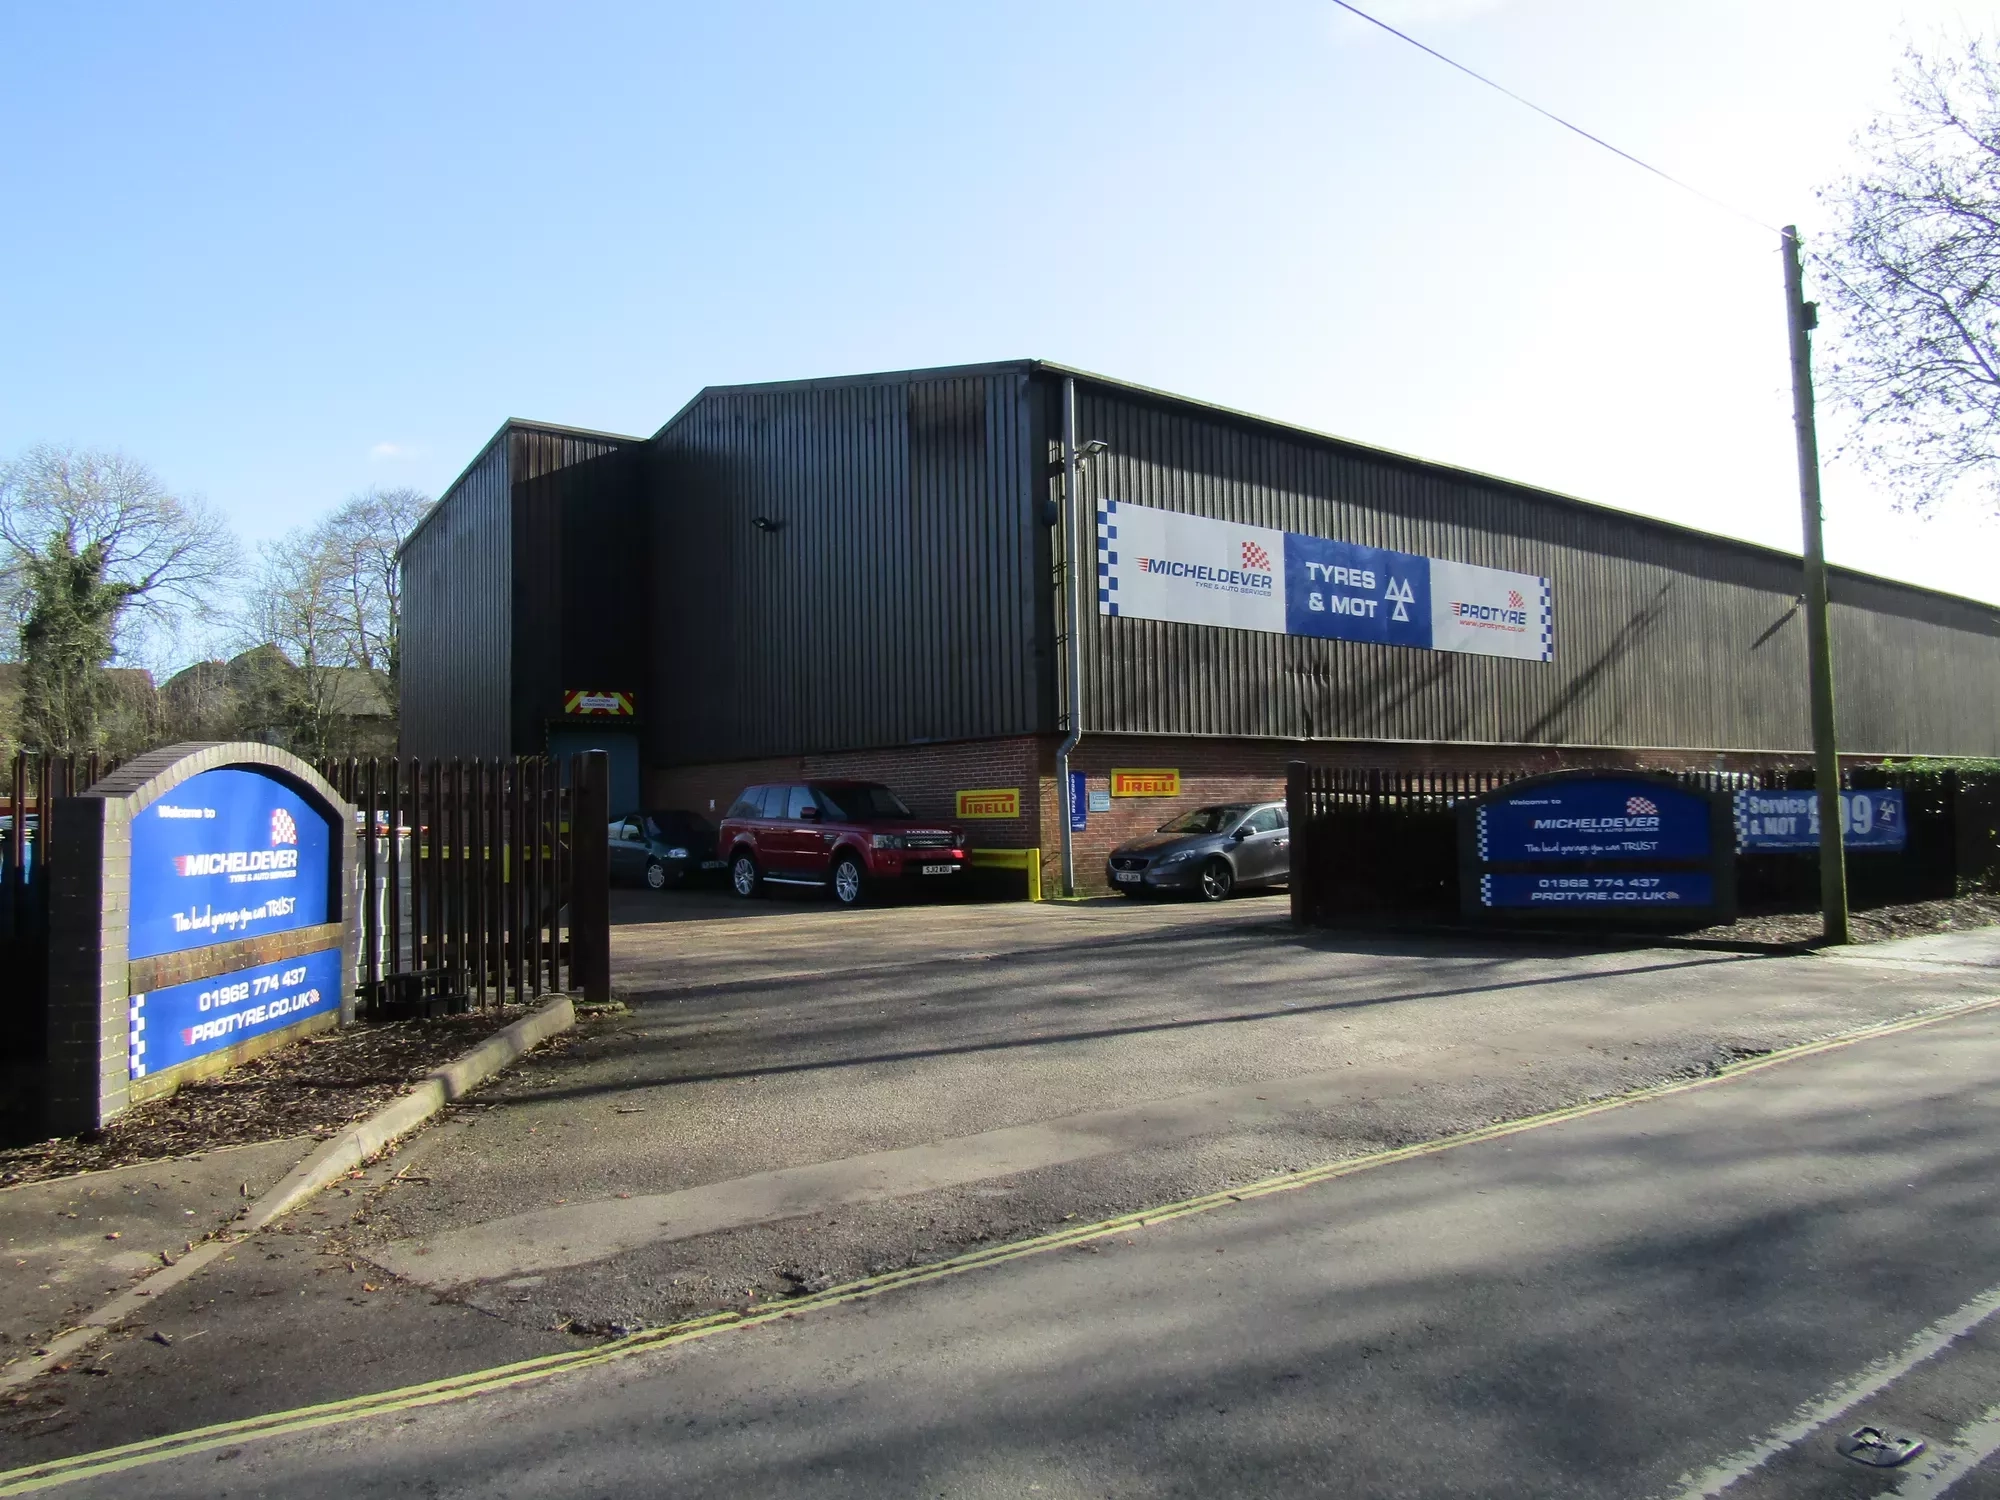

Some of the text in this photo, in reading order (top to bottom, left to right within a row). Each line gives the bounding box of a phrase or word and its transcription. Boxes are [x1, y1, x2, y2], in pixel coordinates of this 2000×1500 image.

[1148, 559, 1272, 589] MICHELDEVER
[1305, 561, 1376, 589] TYRES
[1195, 581, 1213, 590] TYRE
[1221, 585, 1239, 593] AUTO
[1240, 587, 1272, 597] SERVICES
[1308, 592, 1378, 618] & MOT
[1460, 603, 1527, 625] PROTYRE
[1459, 620, 1526, 632] www.protyre.co.uk
[1116, 773, 1176, 792] PIRELLI
[157, 805, 216, 819] Welcome to
[960, 793, 1016, 814] PIRELLI
[1750, 796, 1806, 814] Service
[1534, 817, 1660, 829] MICHELDEVER
[1751, 817, 1796, 835] & MOT
[1525, 843, 1541, 853] The
[1542, 841, 1559, 852] local
[1561, 845, 1589, 855] garage
[1590, 844, 1604, 855] you
[1622, 840, 1659, 851] TRUST
[184, 849, 298, 877] MICHELDEVER
[229, 873, 248, 884] TYRE
[253, 872, 270, 881] AUTO
[1538, 878, 1660, 888] 01962 774 437
[1531, 891, 1667, 901] PROTYRE.CO.UK
[172, 896, 296, 934] The local garage you can TRUST
[199, 966, 307, 1012] 01962 774 437
[190, 991, 311, 1045] PROTYRE.CO.UK
